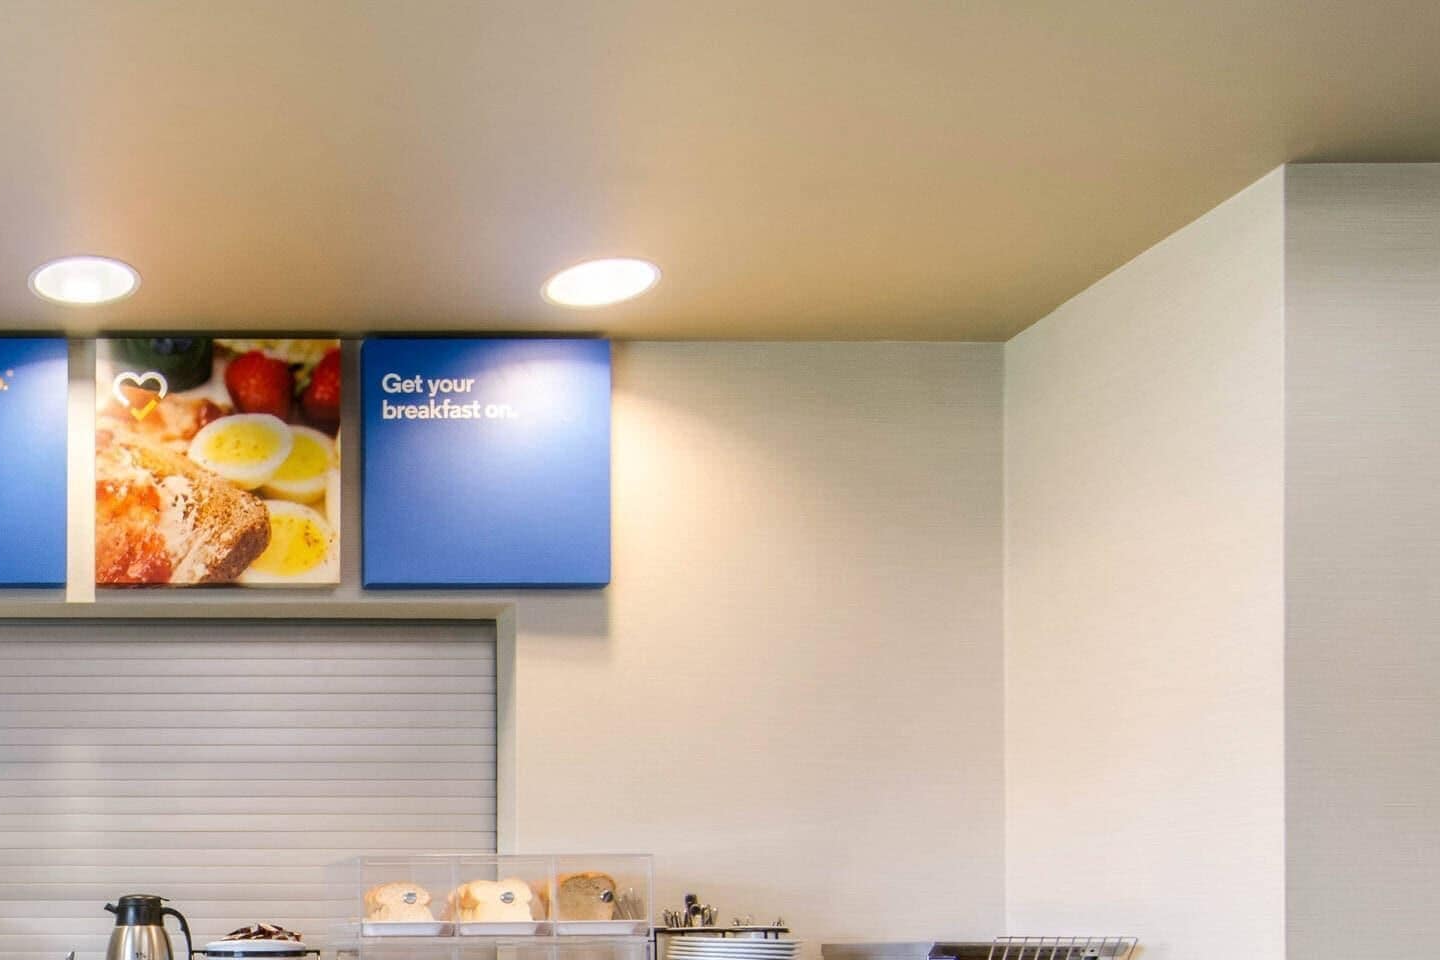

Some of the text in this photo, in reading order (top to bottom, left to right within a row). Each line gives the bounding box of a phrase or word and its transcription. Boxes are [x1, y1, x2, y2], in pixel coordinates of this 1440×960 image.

[382, 373, 475, 397] Get your
[383, 399, 481, 419] breakfast
